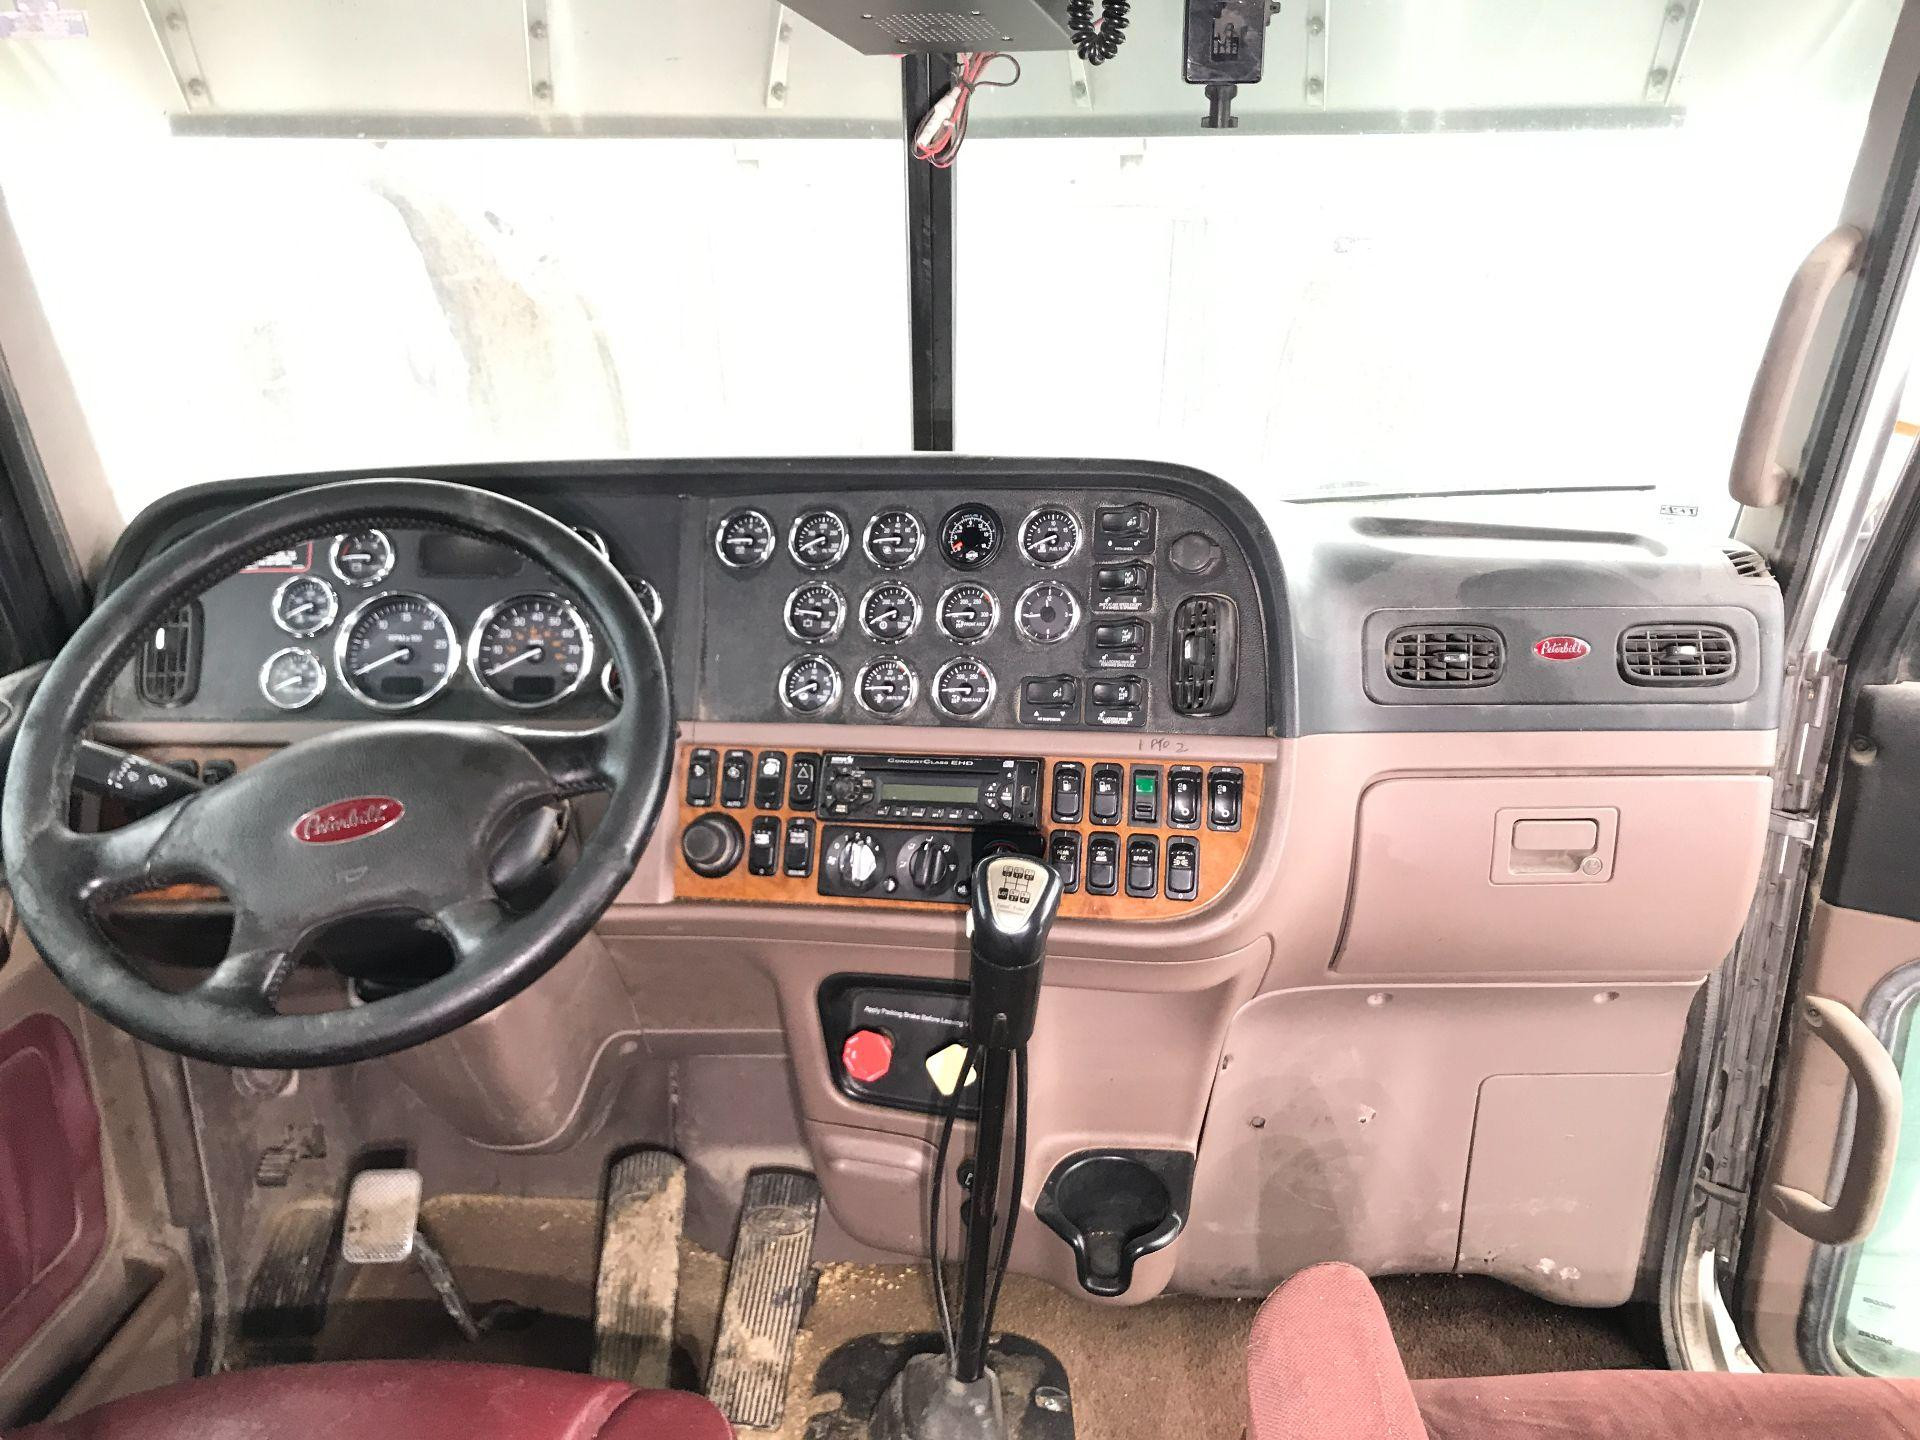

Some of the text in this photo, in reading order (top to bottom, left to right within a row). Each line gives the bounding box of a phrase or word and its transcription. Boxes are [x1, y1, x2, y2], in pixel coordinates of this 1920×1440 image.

[514, 616, 526, 627] 30
[532, 612, 544, 622] 40
[549, 617, 561, 627] 50
[422, 621, 435, 630] 20
[499, 629, 512, 638] 20
[561, 629, 574, 638] 60
[363, 639, 370, 650] 5
[434, 640, 448, 650] 25
[1541, 640, 1582, 655] Peterbilt
[568, 645, 580, 655] 70
[433, 663, 446, 673] 30
[1176, 742, 1189, 753] 2
[304, 804, 388, 840] Peterbilt
[864, 1005, 881, 1015] Apply
[882, 1007, 903, 1019] Parking
[904, 1011, 921, 1020] Brake
[922, 1014, 941, 1024] Before
[941, 1017, 964, 1028] Leaving
